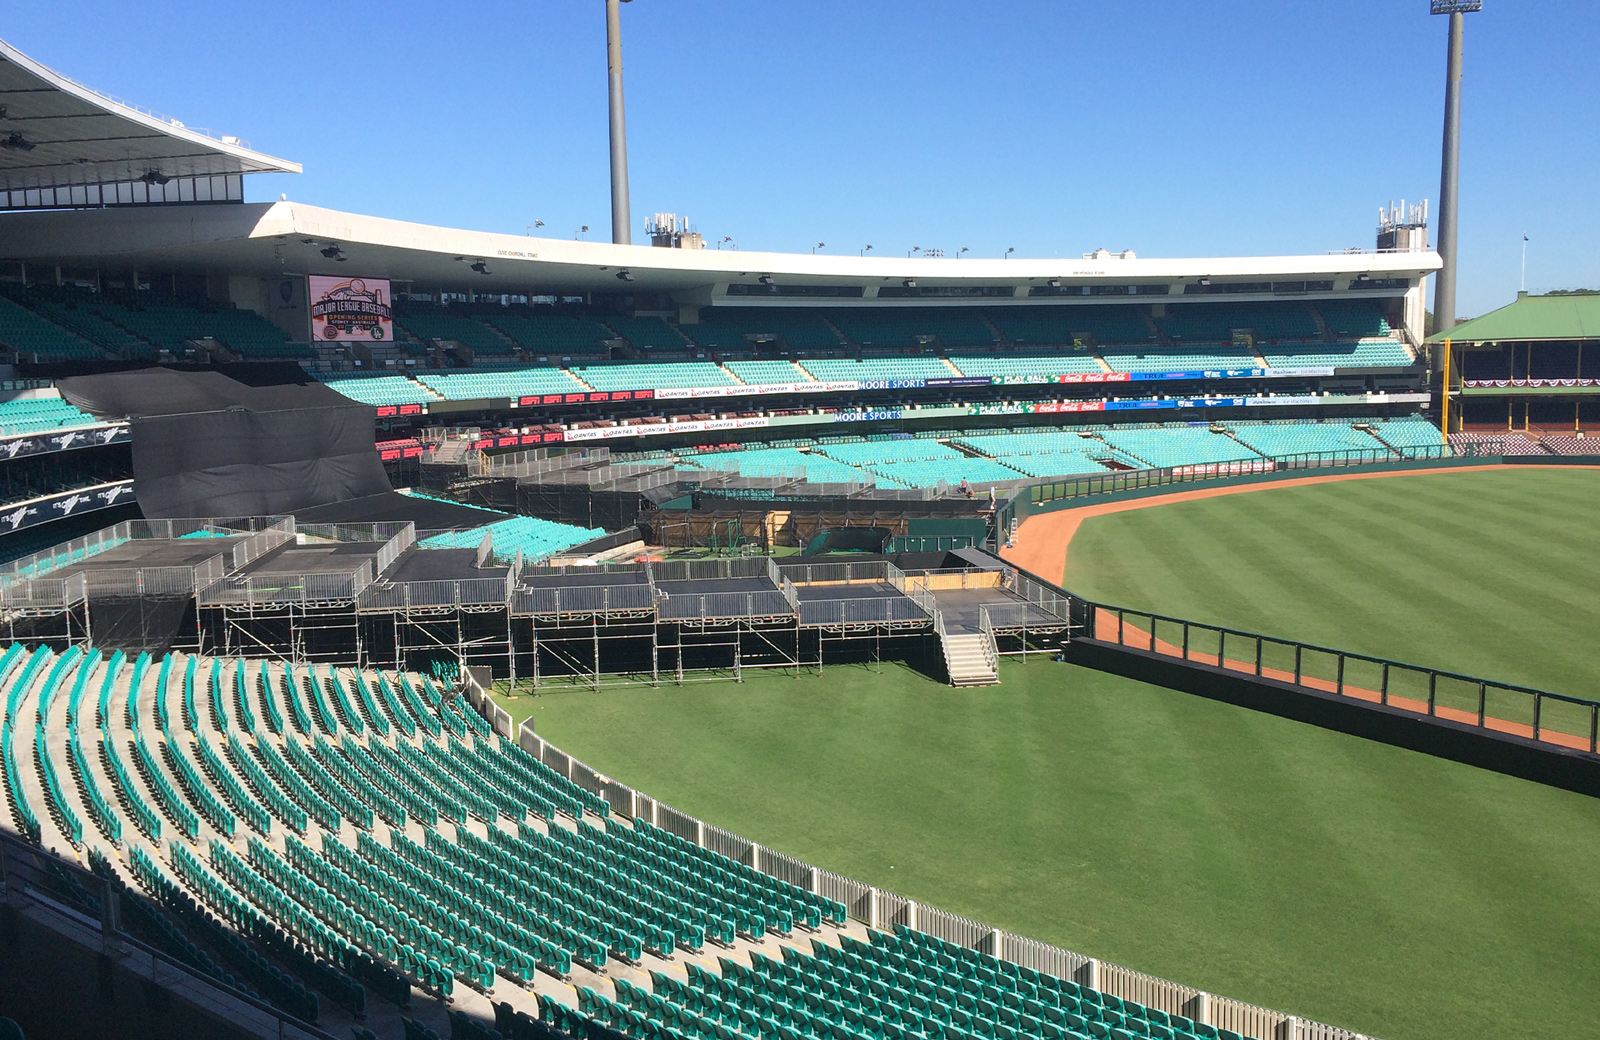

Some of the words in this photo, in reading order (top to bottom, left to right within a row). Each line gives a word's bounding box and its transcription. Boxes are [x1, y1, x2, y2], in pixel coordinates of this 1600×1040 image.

[314, 302, 336, 316] MAJOR
[338, 301, 360, 311] LEAGUE
[362, 302, 390, 318] BASEBALL
[859, 380, 889, 389] MOORE
[893, 379, 925, 388] SPORTS
[566, 394, 585, 403] ESPN
[590, 393, 609, 401] ESPN
[612, 391, 631, 400] ESPN
[634, 390, 653, 399] ESPN
[520, 396, 540, 405] ESPN
[543, 395, 562, 404] ESPN
[377, 406, 397, 416] ESPN
[400, 405, 420, 415] ESPN
[835, 412, 867, 422] MOORE
[870, 411, 901, 420] SPORTS
[498, 437, 518, 446] ESPN
[521, 435, 541, 444] ESPN
[544, 433, 563, 442] ESPN
